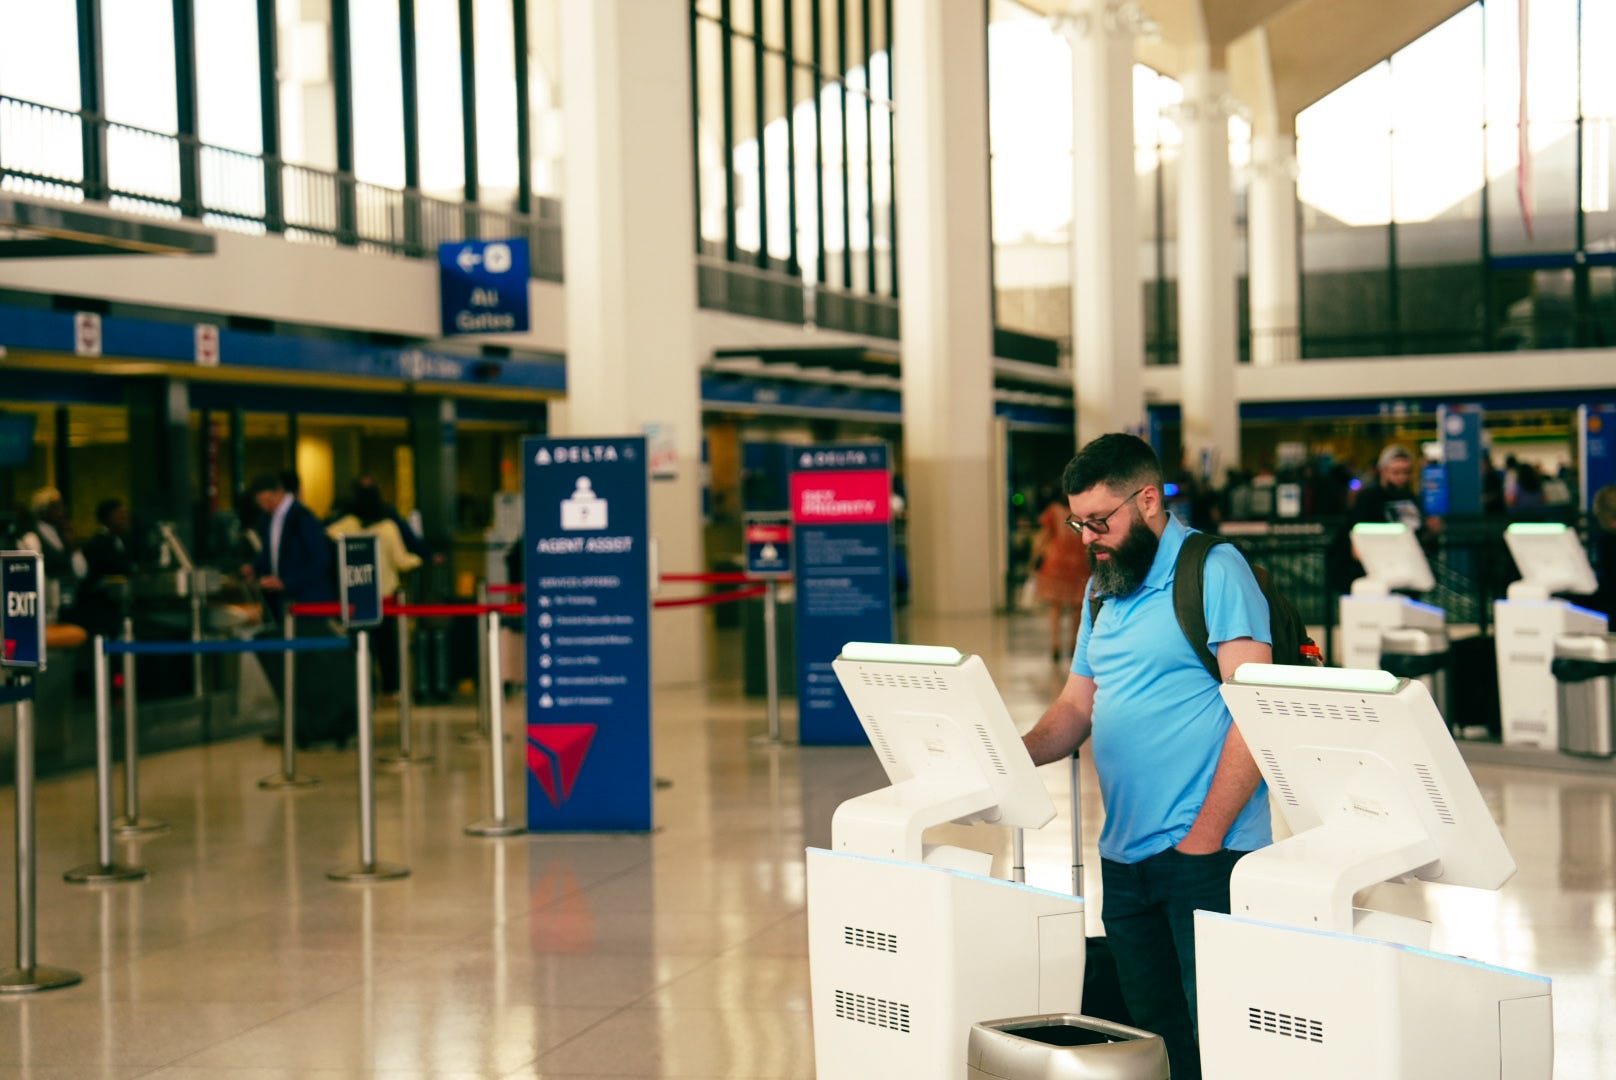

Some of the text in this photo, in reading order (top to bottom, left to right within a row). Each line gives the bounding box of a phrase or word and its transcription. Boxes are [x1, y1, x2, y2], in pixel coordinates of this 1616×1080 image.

[471, 288, 498, 306] All
[456, 312, 514, 329] Gates
[553, 445, 618, 463] DELTA
[814, 451, 866, 466] DELTA
[802, 500, 876, 516] PRIORITY
[537, 536, 633, 554] AGENT ASSIST
[346, 564, 373, 587] EXIT
[7, 591, 37, 617] EXIT
